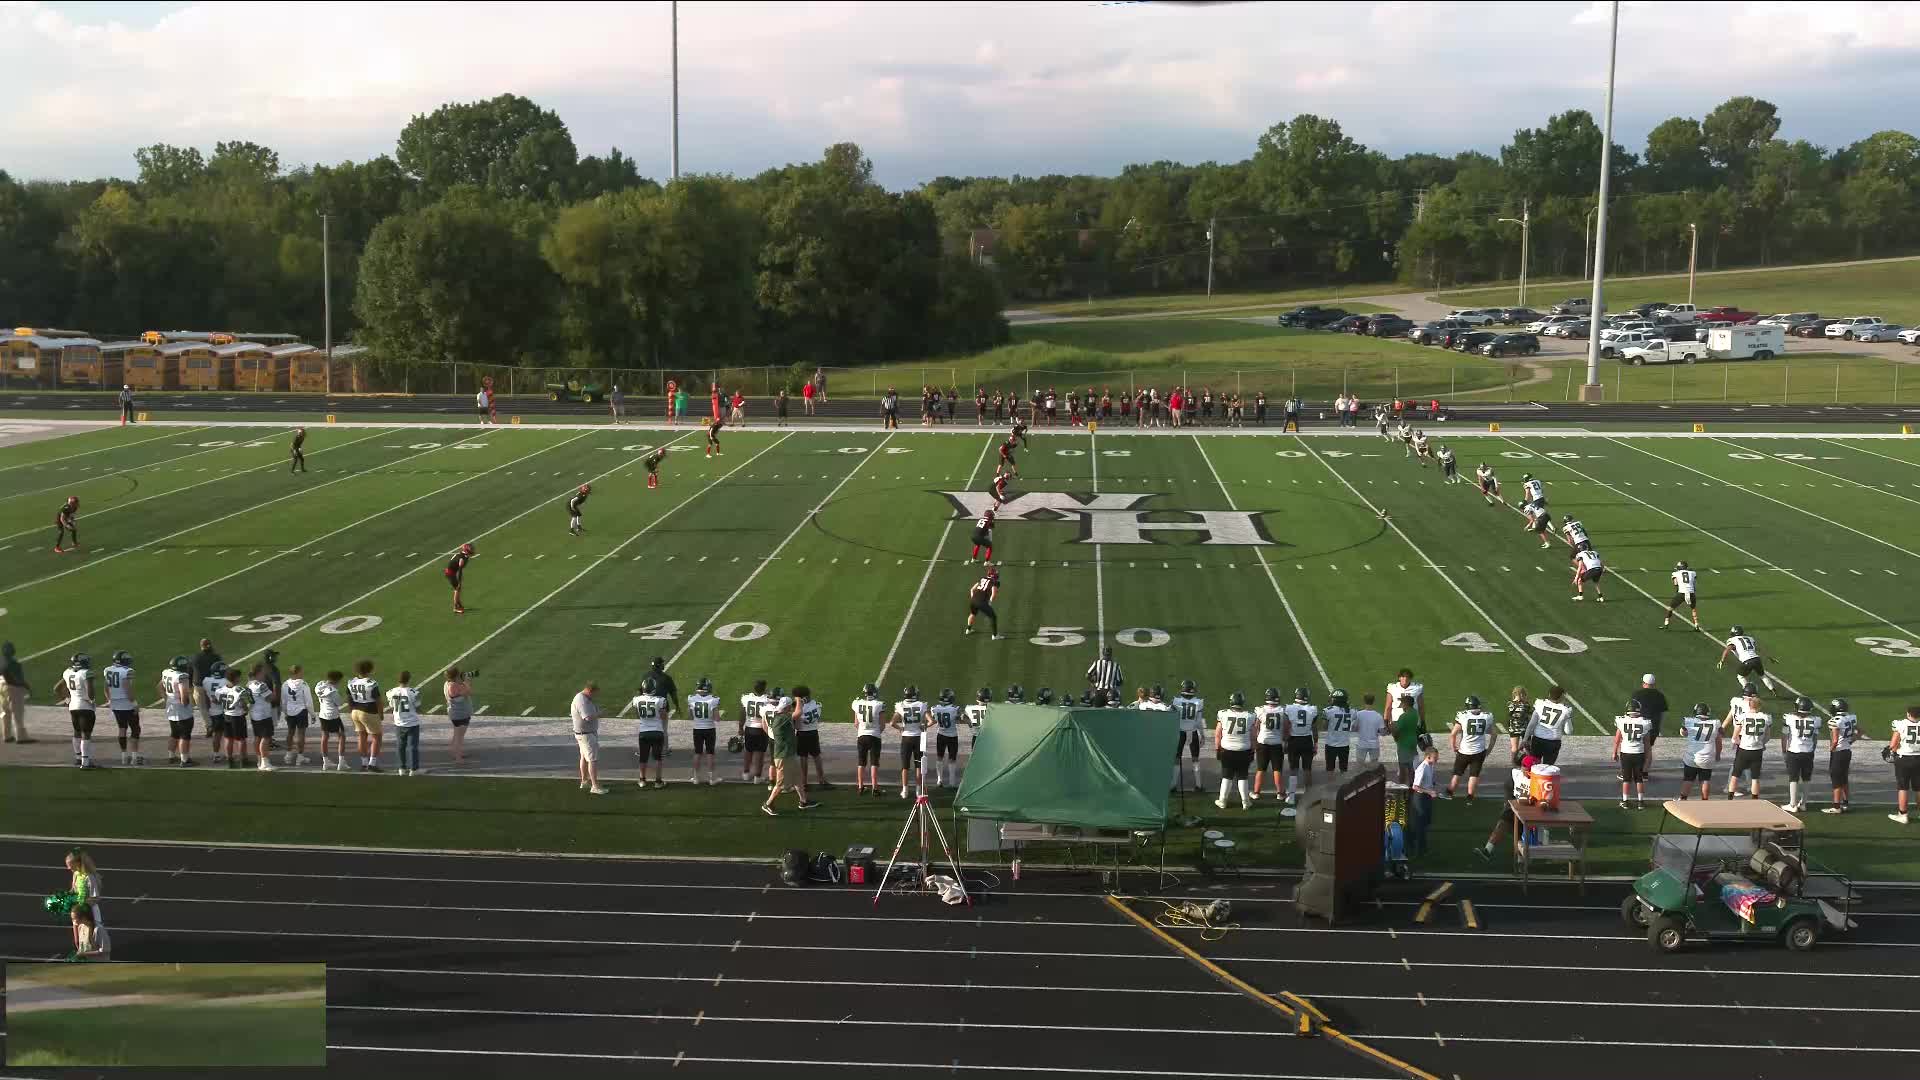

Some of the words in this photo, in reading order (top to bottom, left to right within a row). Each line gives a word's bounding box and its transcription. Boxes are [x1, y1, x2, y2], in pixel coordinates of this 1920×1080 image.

[1682, 571, 1690, 584] 8
[229, 613, 383, 634] 30
[629, 620, 771, 642] 40
[1028, 626, 1172, 648] 50
[1440, 632, 1589, 654] 40
[68, 674, 76, 691] 6
[858, 704, 873, 723] 41
[903, 707, 921, 724] 25
[1181, 702, 1197, 720] 10
[1297, 710, 1307, 728] 9
[1539, 705, 1563, 727] 57
[1227, 716, 1247, 735] 79
[1334, 713, 1352, 732] 75
[1693, 722, 1714, 742] 77
[1745, 717, 1766, 736] 22
[1795, 719, 1815, 738] 45
[1623, 723, 1644, 742] 42
